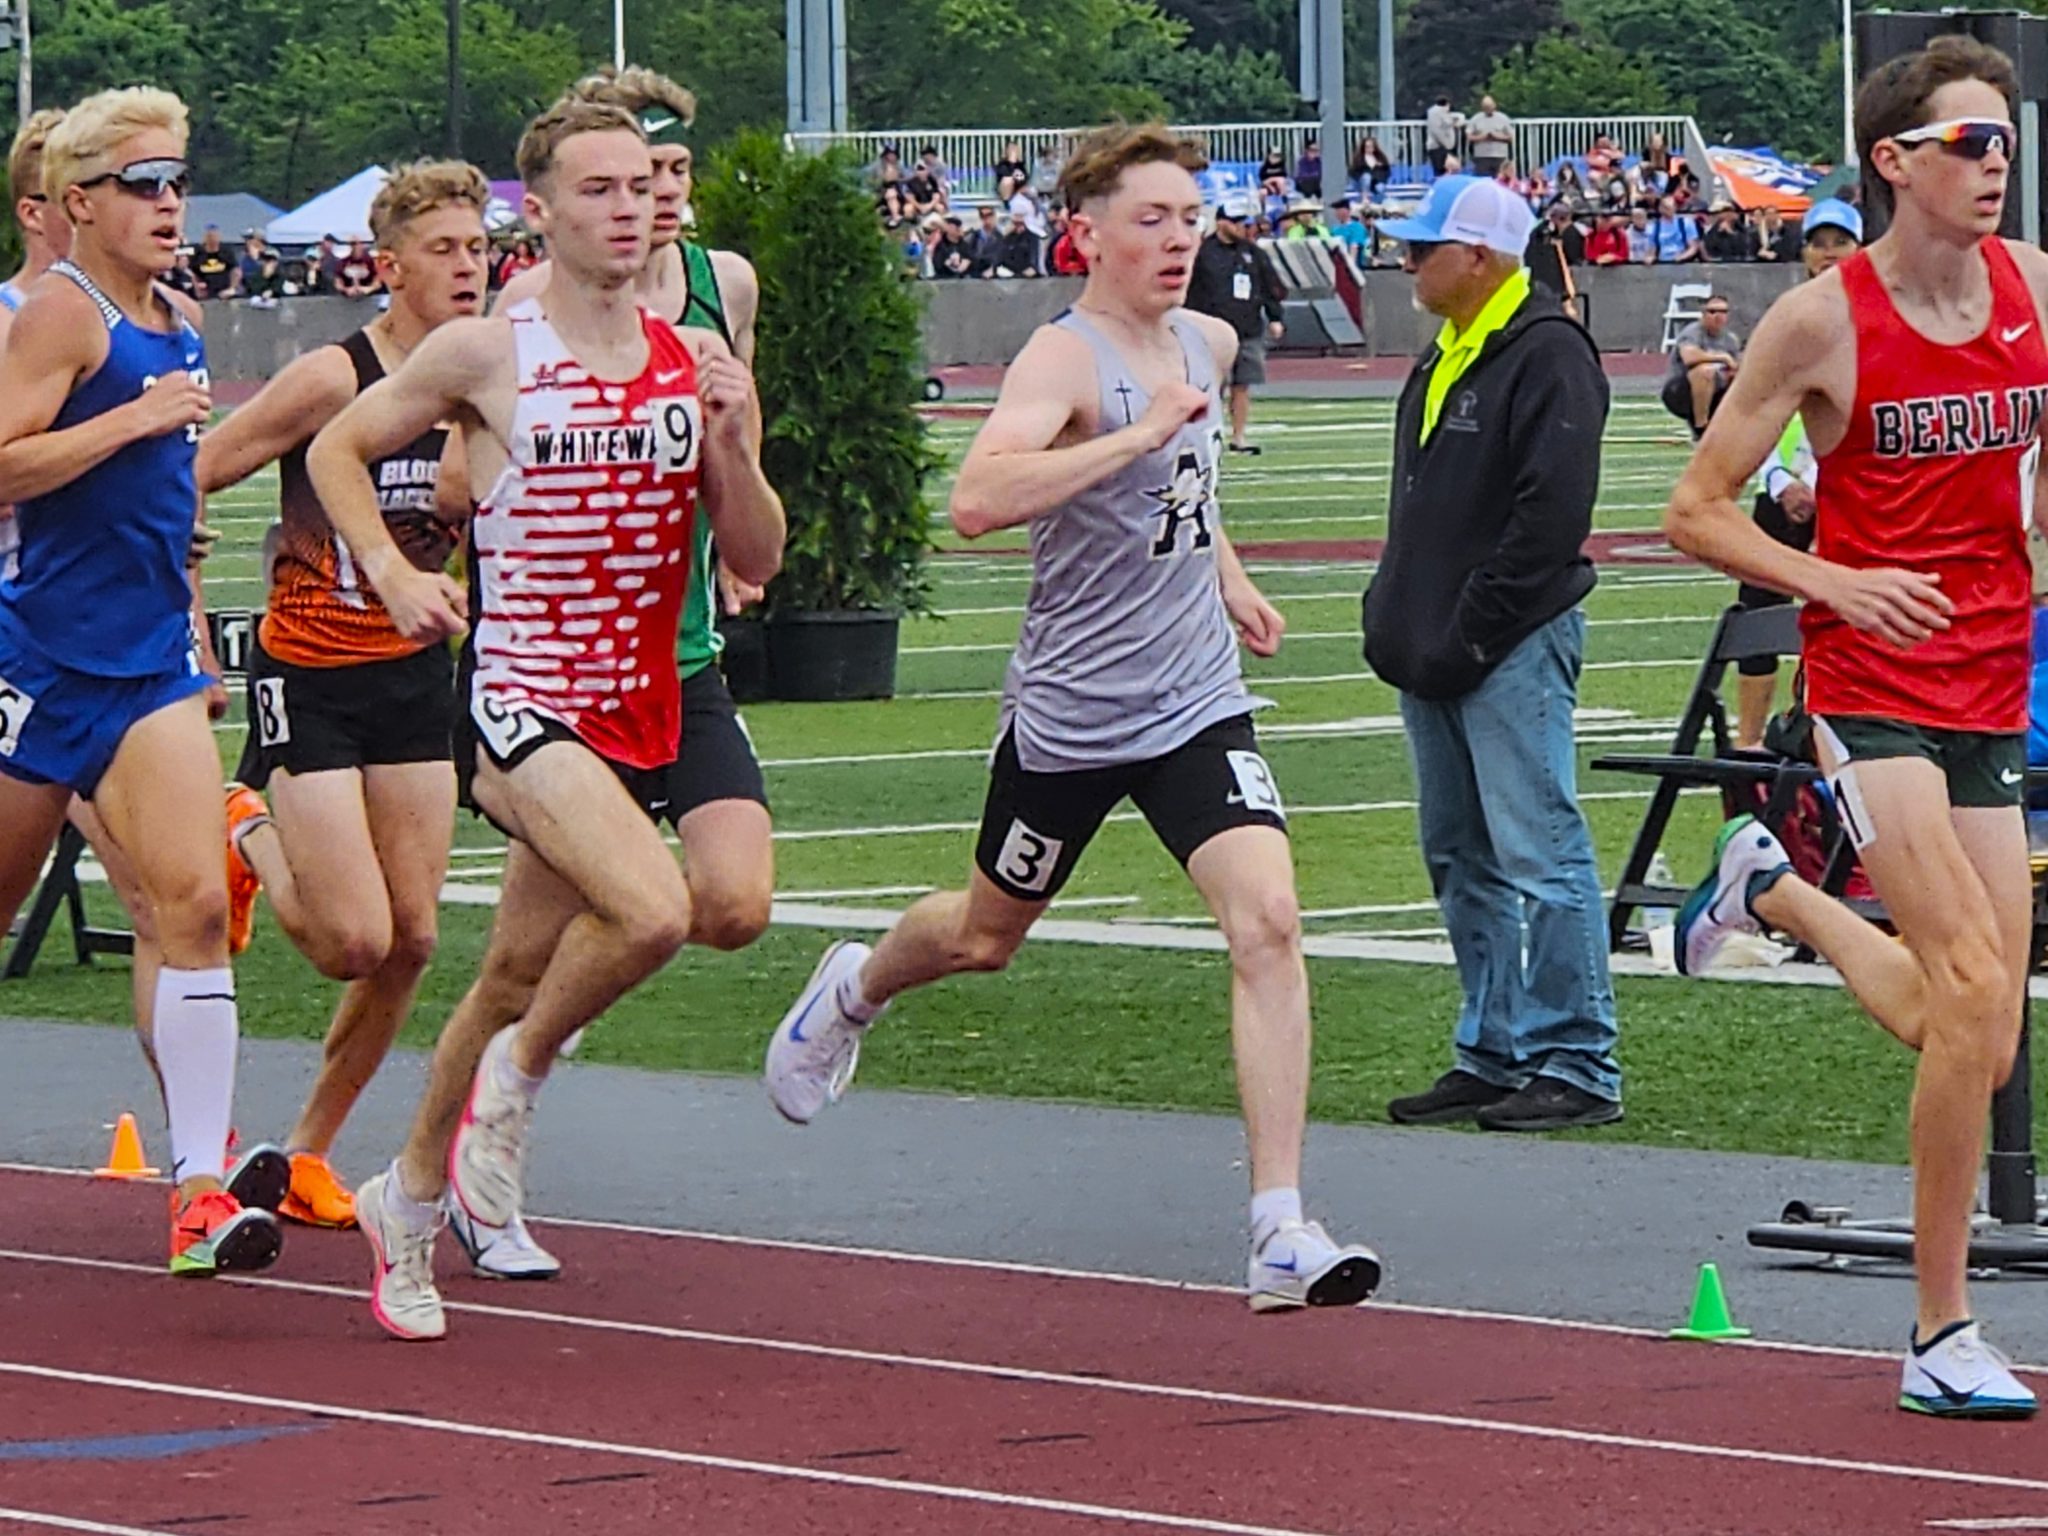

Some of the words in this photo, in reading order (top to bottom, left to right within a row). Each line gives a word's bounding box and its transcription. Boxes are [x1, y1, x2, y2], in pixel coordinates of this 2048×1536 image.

[664, 402, 693, 467] 9
[379, 458, 441, 487] BLOO
[260, 683, 279, 740] 8
[1244, 756, 1278, 806] 3
[1006, 832, 1048, 884] 3
